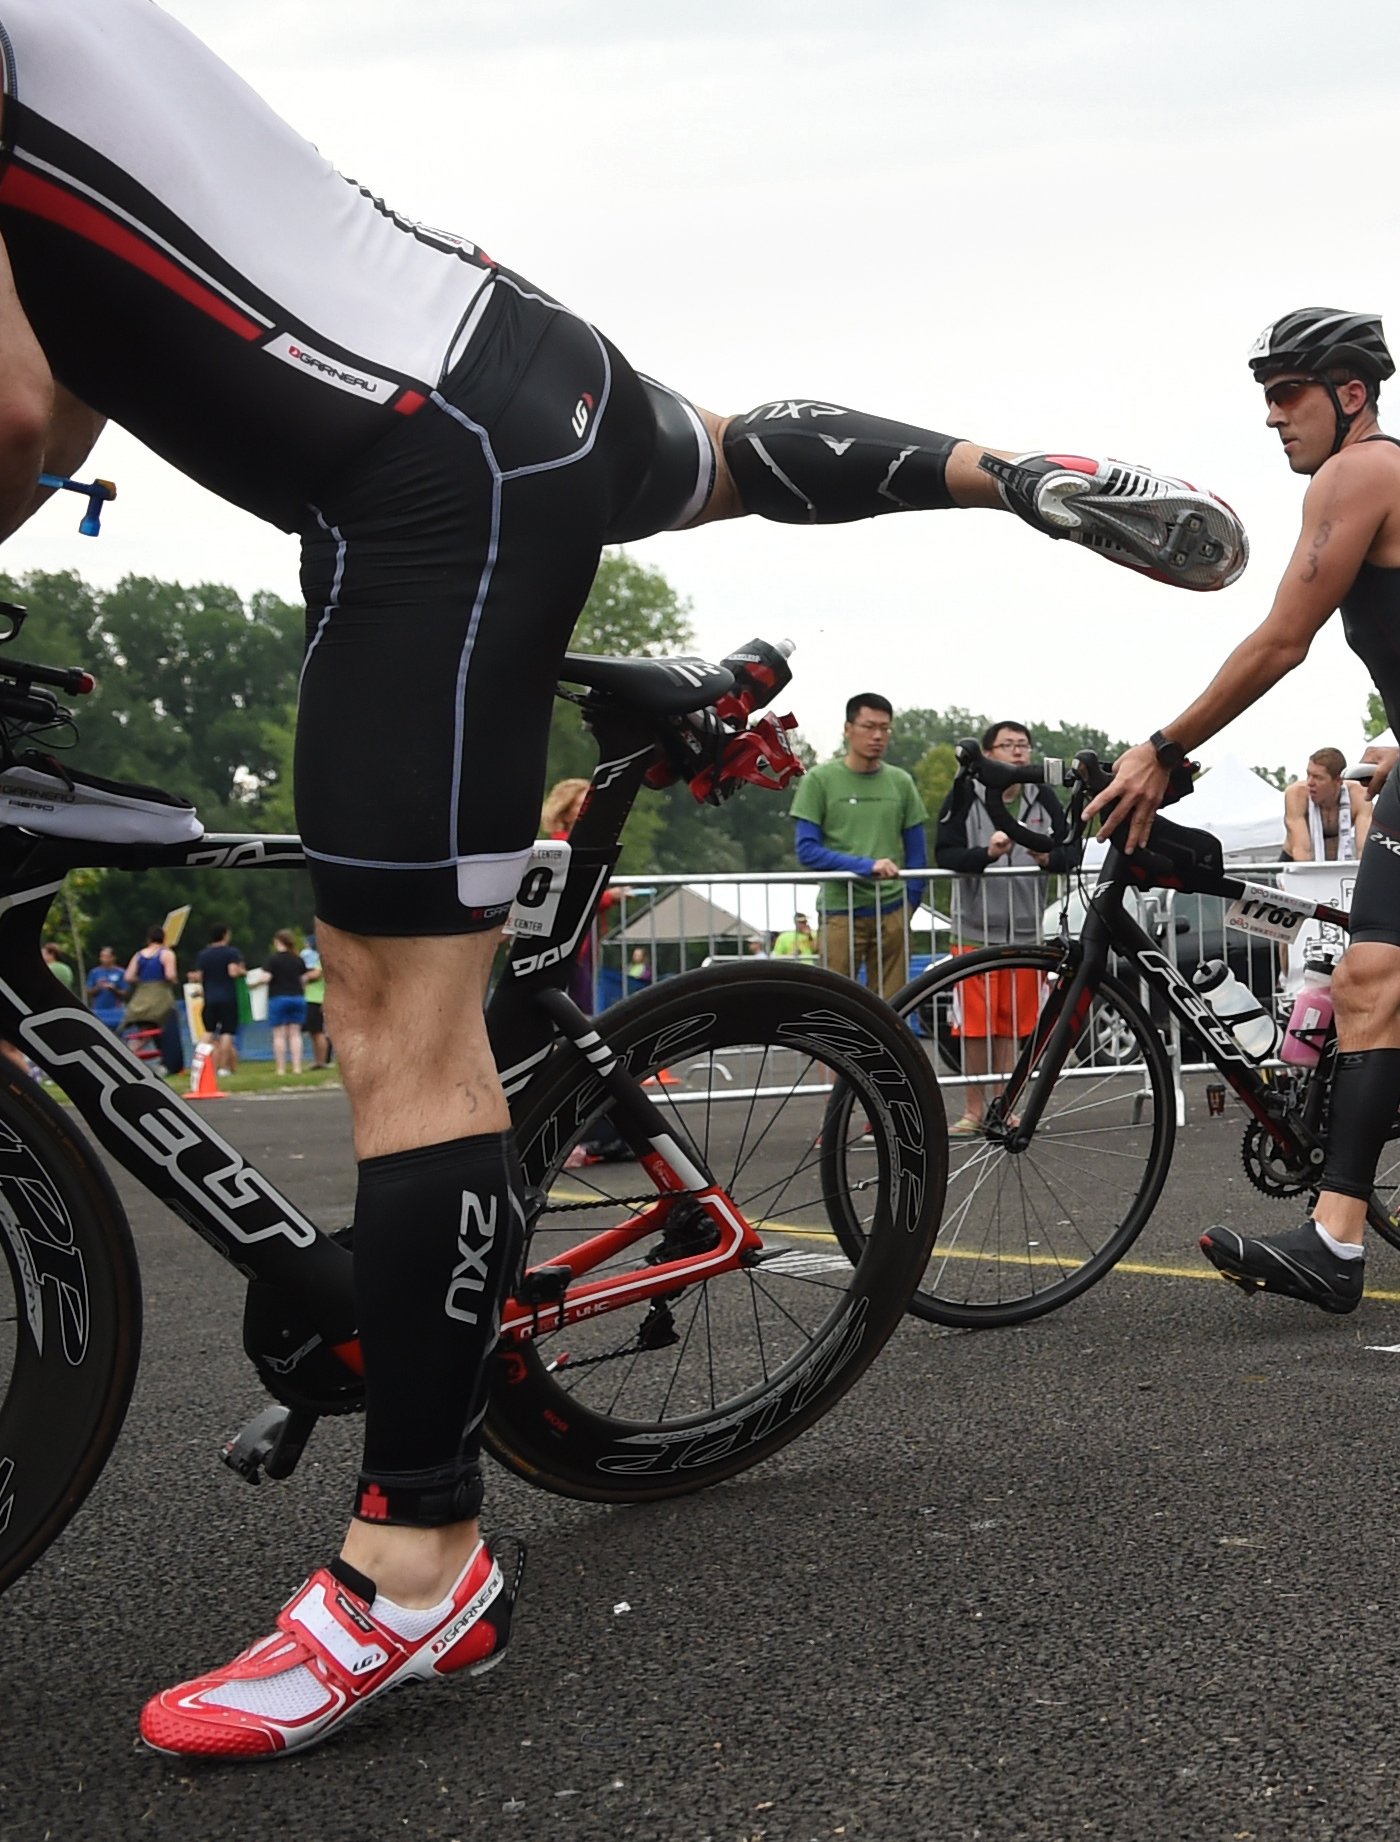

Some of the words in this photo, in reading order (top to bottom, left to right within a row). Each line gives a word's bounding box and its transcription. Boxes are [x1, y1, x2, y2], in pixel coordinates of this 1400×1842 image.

[299, 352, 377, 393] GARNEAU
[8, 799, 55, 812] AERO
[538, 850, 563, 860] CENTER
[514, 918, 543, 932] CENTER
[1137, 951, 1257, 1069] FELT
[19, 1007, 317, 1249] FELT
[776, 1009, 926, 1223] ZIPP
[444, 1189, 498, 1326] 2XU
[595, 1296, 870, 1475] ZIPP
[444, 1570, 501, 1644] GARNEAU
